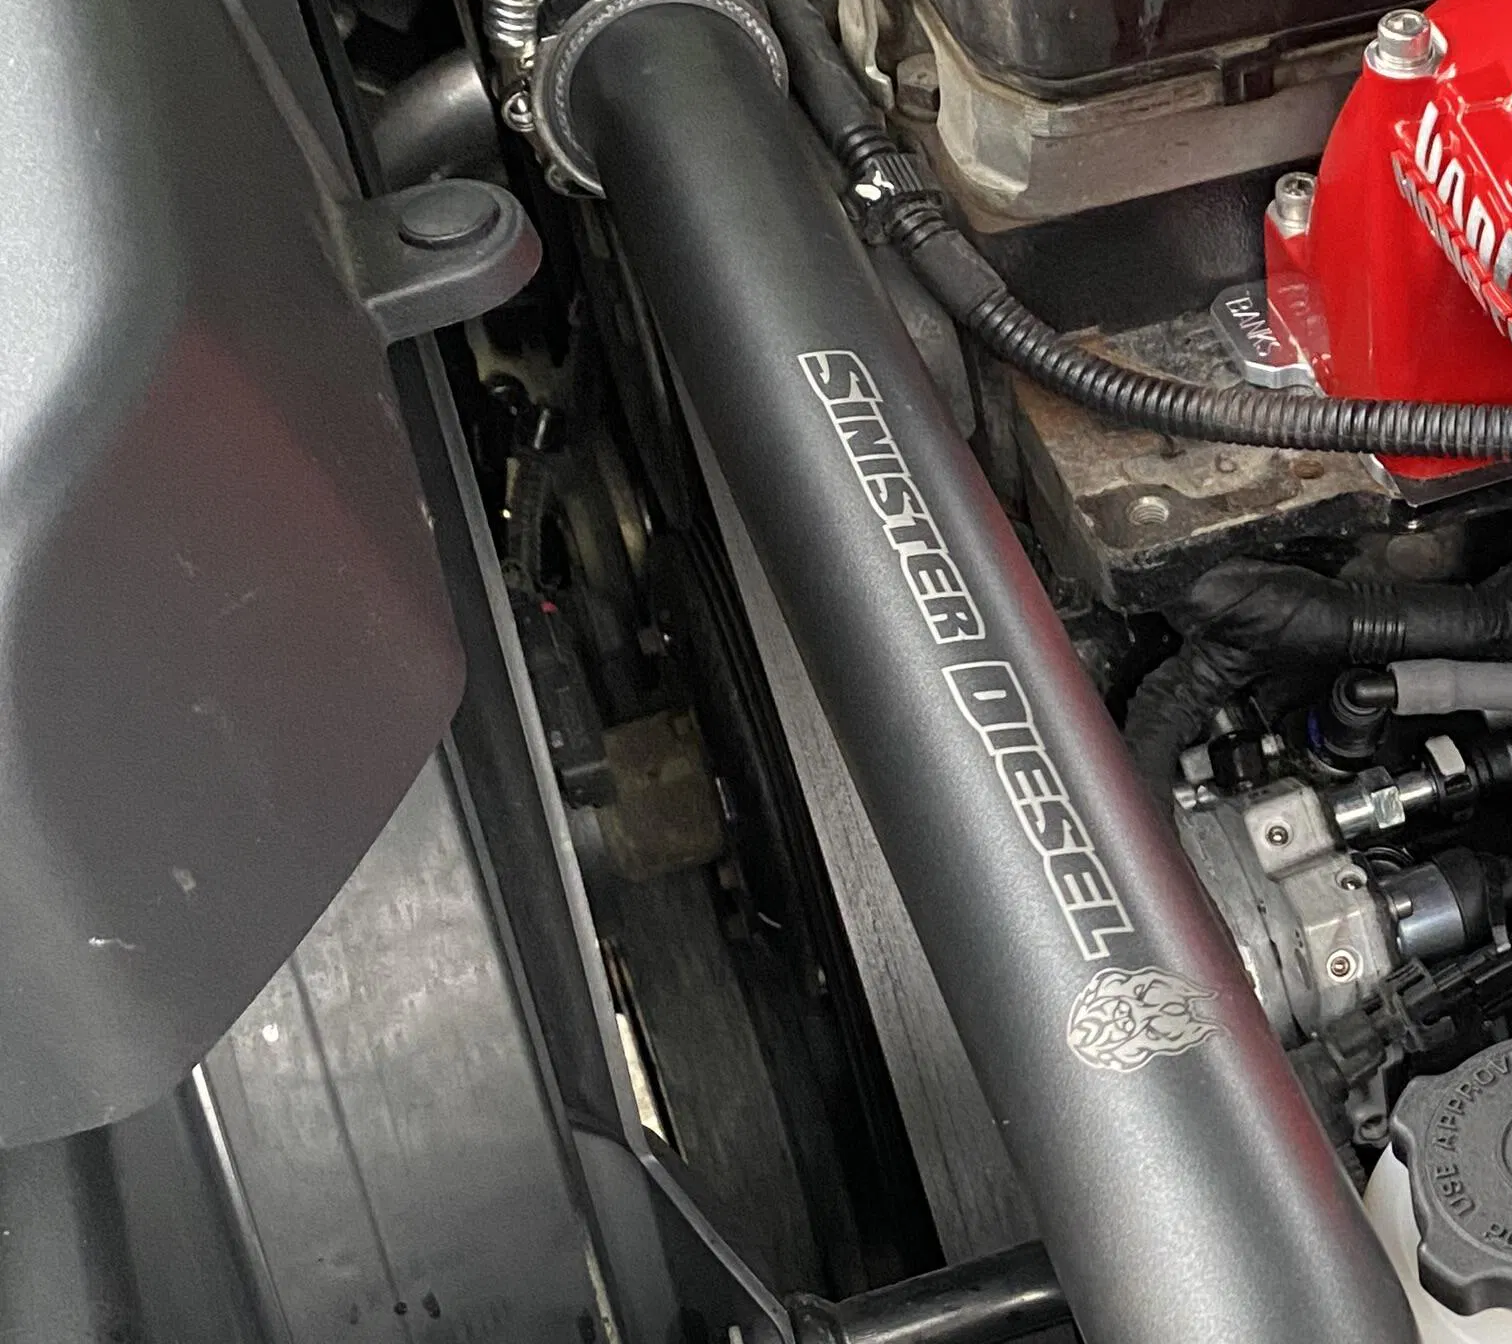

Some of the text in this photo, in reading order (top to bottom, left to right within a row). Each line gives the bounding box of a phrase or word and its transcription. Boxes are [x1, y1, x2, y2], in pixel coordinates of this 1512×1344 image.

[1224, 291, 1283, 358] BANKS
[799, 349, 1135, 962] SINISTER DIESEL
[1435, 1163, 1477, 1218] USE
